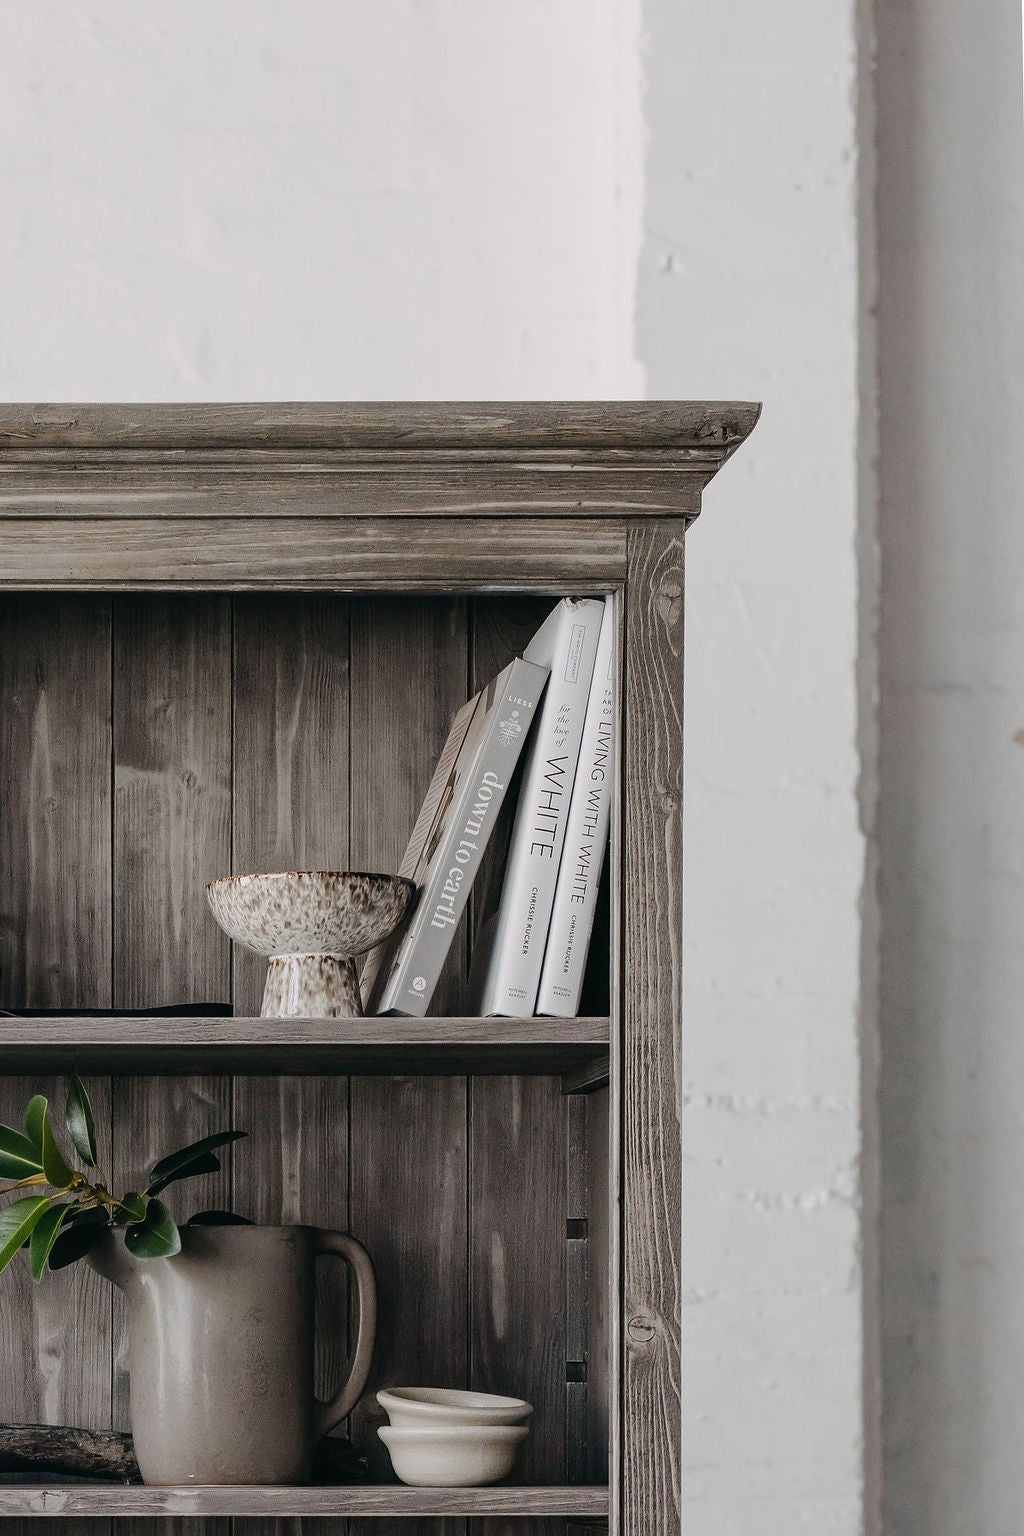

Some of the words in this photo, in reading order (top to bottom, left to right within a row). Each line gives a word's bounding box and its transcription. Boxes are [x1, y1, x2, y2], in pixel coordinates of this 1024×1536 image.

[508, 695, 532, 709] LIESS
[557, 704, 572, 714] for
[553, 726, 570, 736] love
[556, 715, 570, 725] the
[555, 738, 567, 748] of
[590, 722, 612, 782] LIVING
[464, 771, 504, 836] down
[530, 755, 569, 859] WHITE
[582, 788, 603, 838] WITH
[455, 840, 479, 864] to
[571, 844, 593, 905] WHITE
[431, 866, 464, 929] earth
[527, 887, 539, 921] CHRISSIE
[522, 923, 533, 955] RUCKER
[568, 914, 577, 944] CHRISSIE
[562, 946, 573, 974] RUCKER
